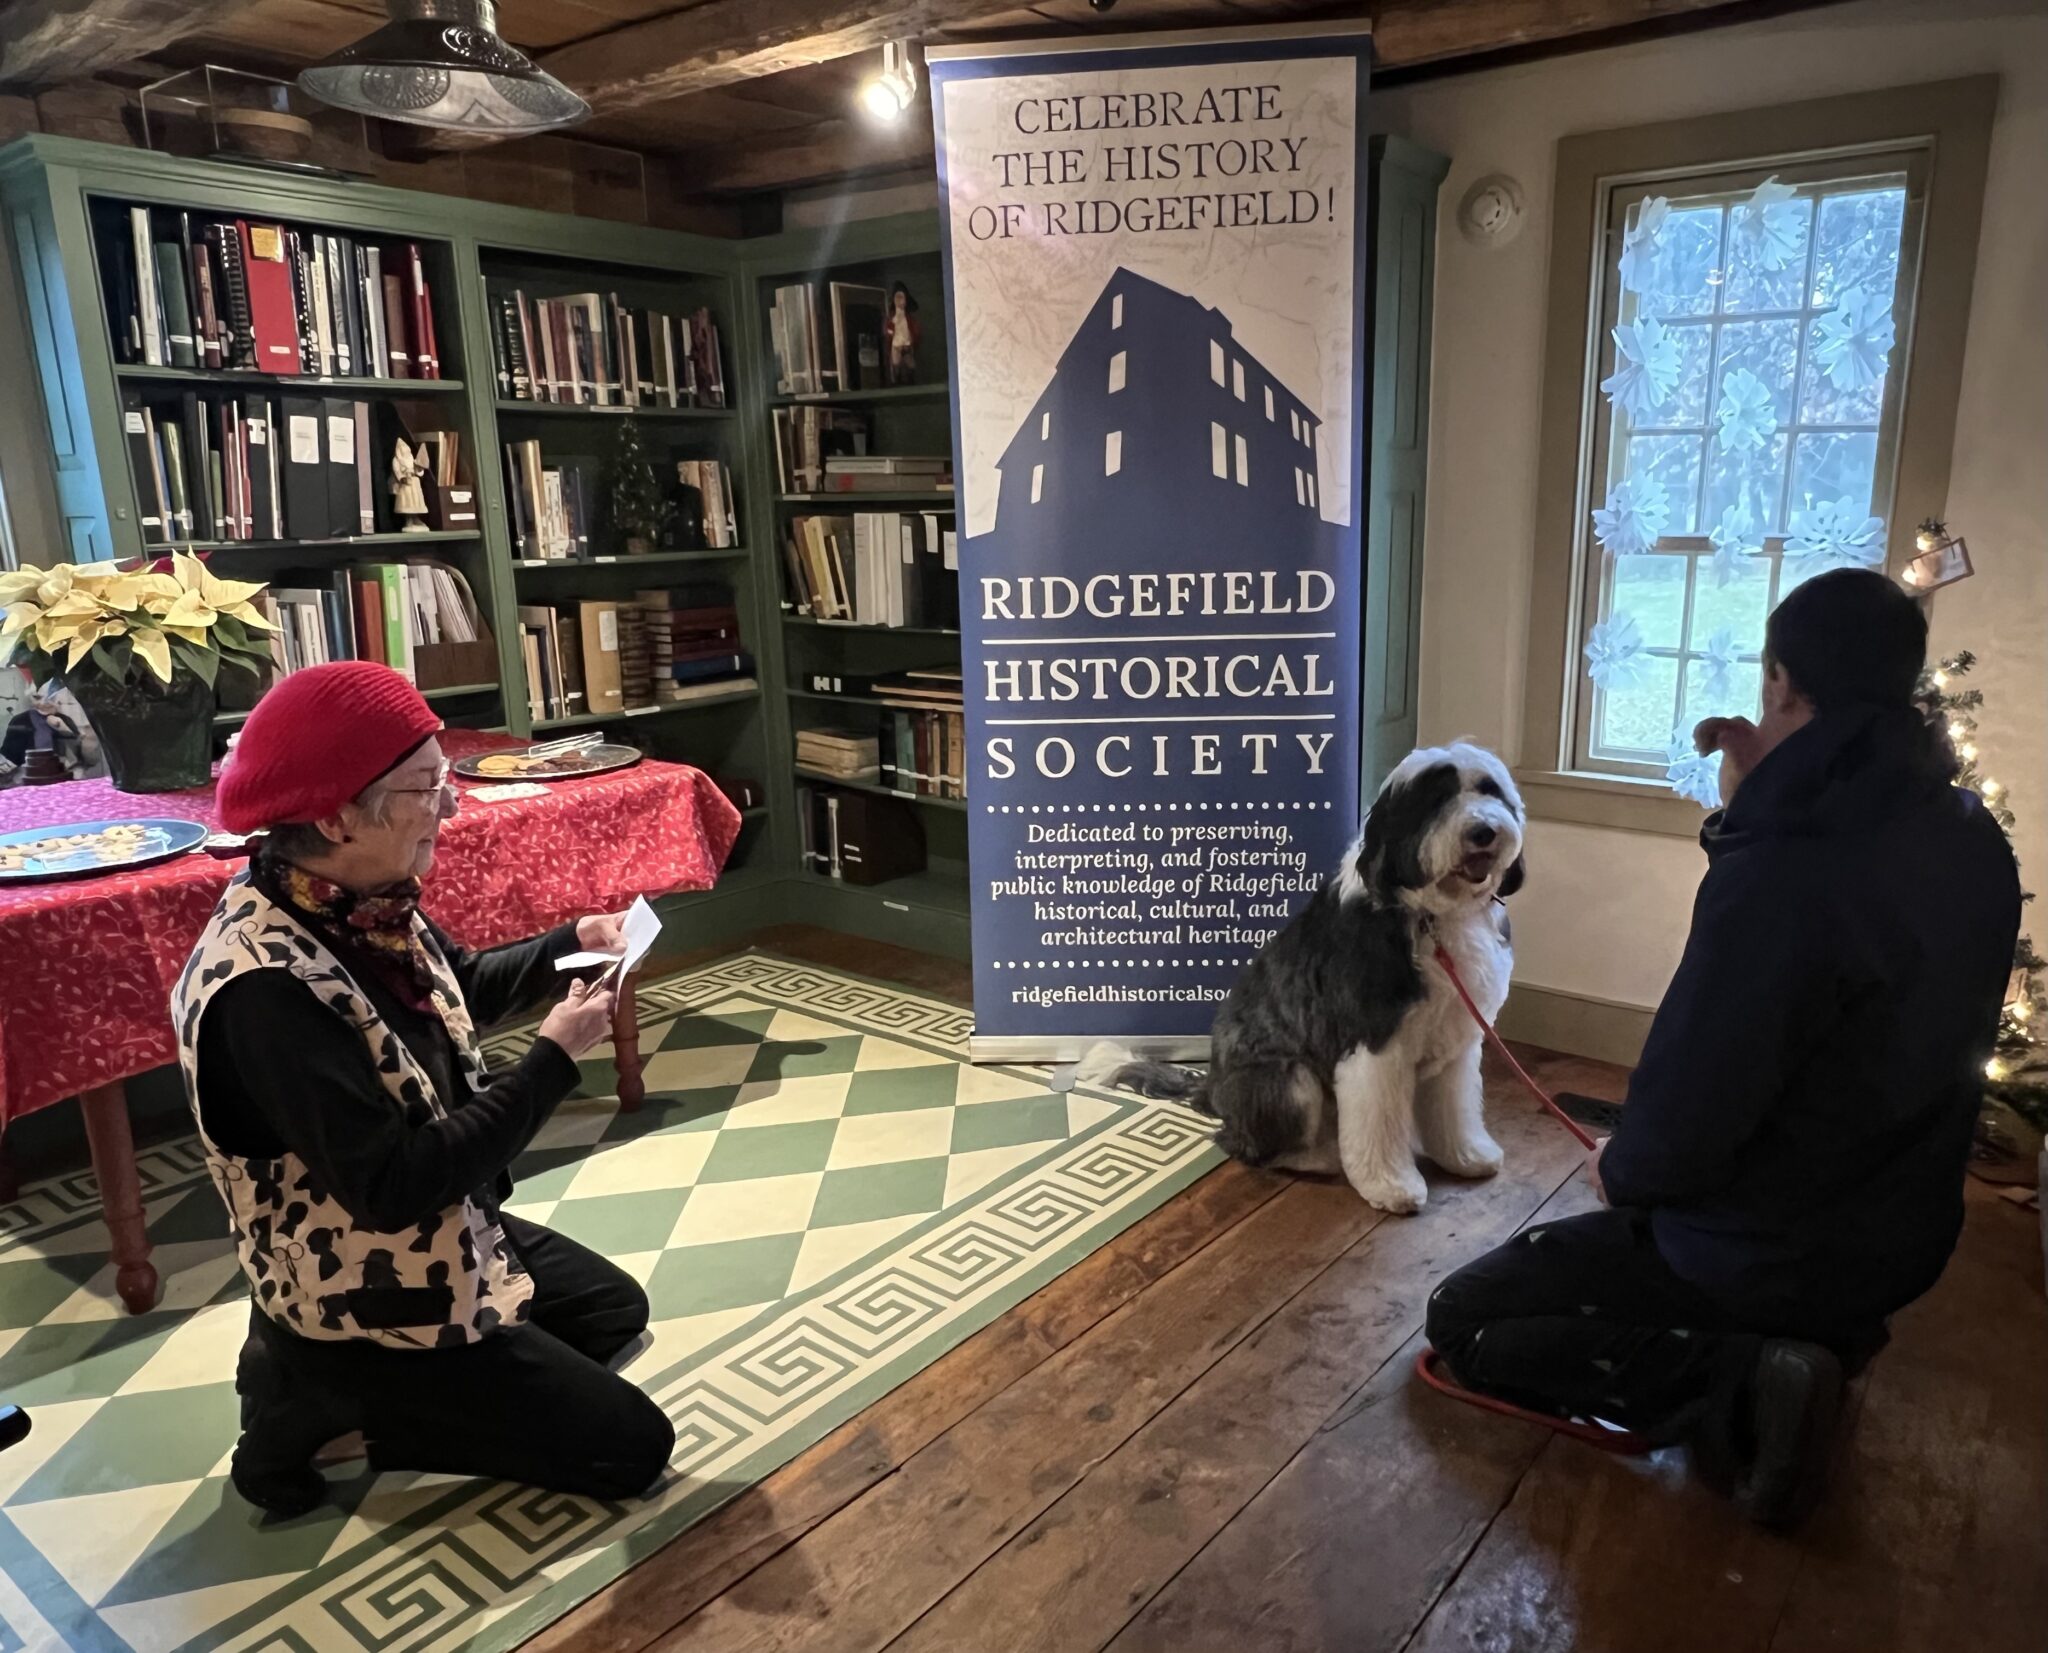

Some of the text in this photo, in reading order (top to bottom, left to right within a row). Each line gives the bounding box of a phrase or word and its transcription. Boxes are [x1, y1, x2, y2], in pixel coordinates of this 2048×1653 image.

[1014, 84, 1283, 135] CELEBRATE
[991, 137, 1308, 188] THE HISTORY
[968, 187, 1335, 241] OF RIDGEFIELD!
[980, 570, 1336, 620] RIDGEFIELD
[983, 654, 1334, 702] HISTORICAL
[986, 733, 1334, 779] SOCIETY
[1027, 820, 1294, 847] Dedicated to preserving,
[1014, 846, 1307, 875] interpreting, and fostering
[990, 872, 1324, 901] public knowledge of Ridgefield'
[1034, 898, 1290, 923] historical, cultural, and
[1040, 925, 1182, 946] architectural
